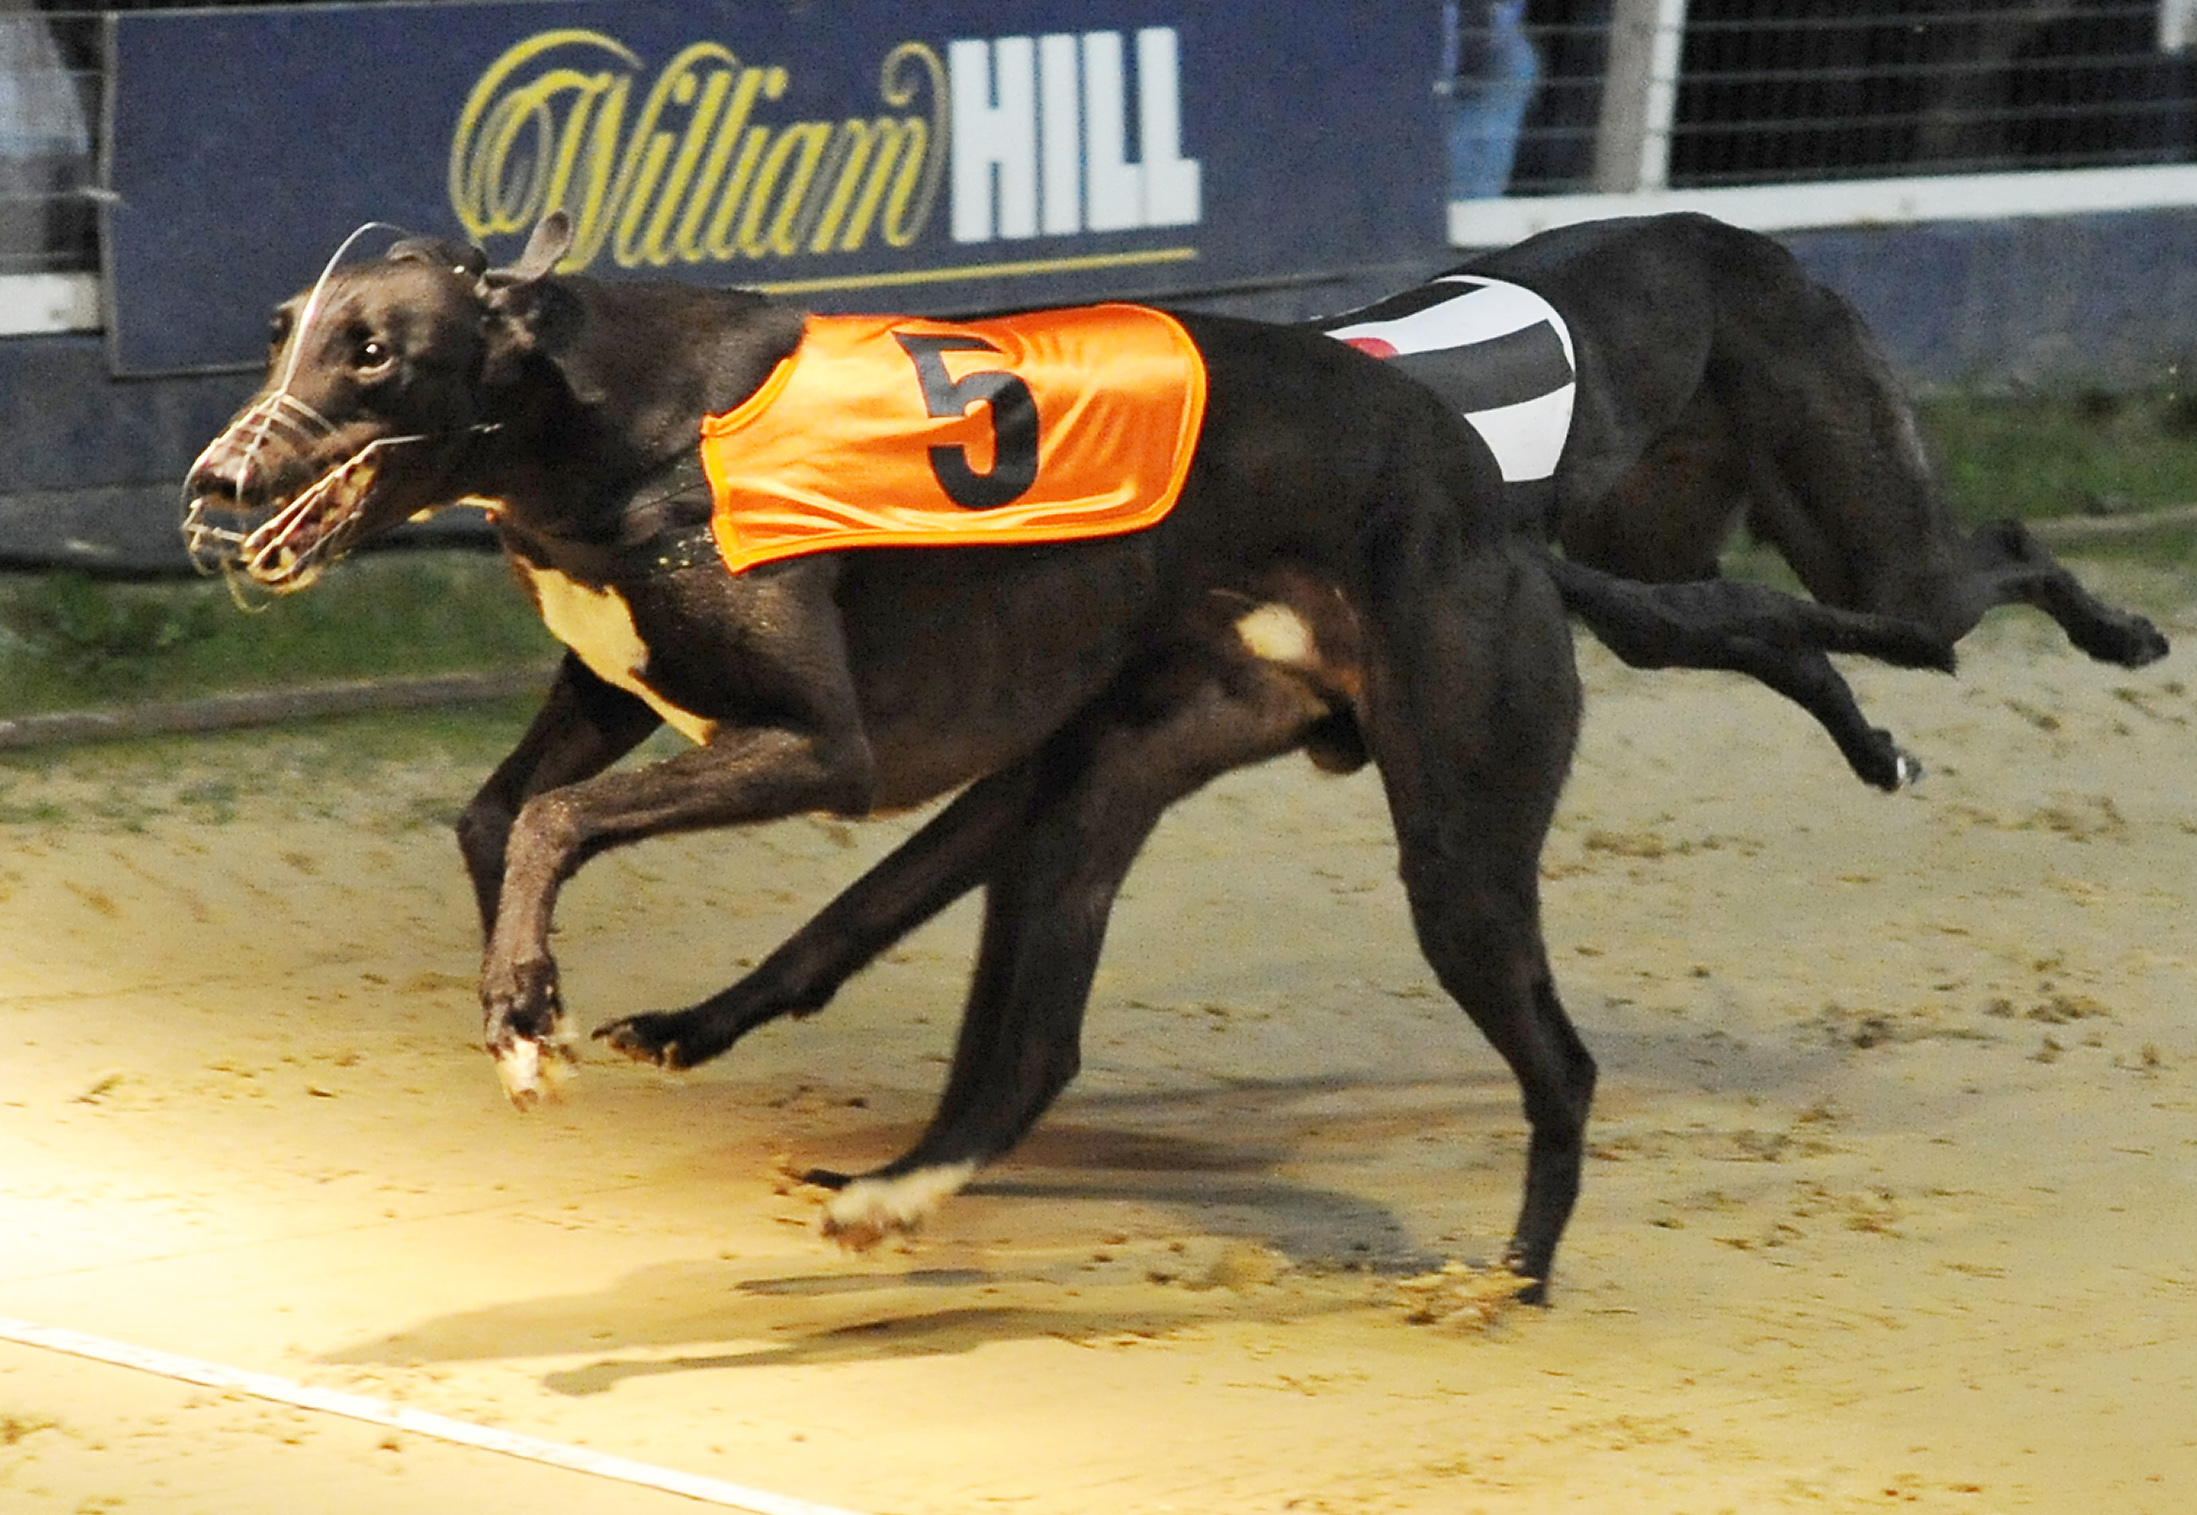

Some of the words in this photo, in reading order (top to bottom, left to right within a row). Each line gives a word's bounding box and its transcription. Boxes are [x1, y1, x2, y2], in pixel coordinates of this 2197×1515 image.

[449, 29, 948, 274] William
[949, 27, 1200, 244] HILL
[893, 333, 1040, 510] 5
